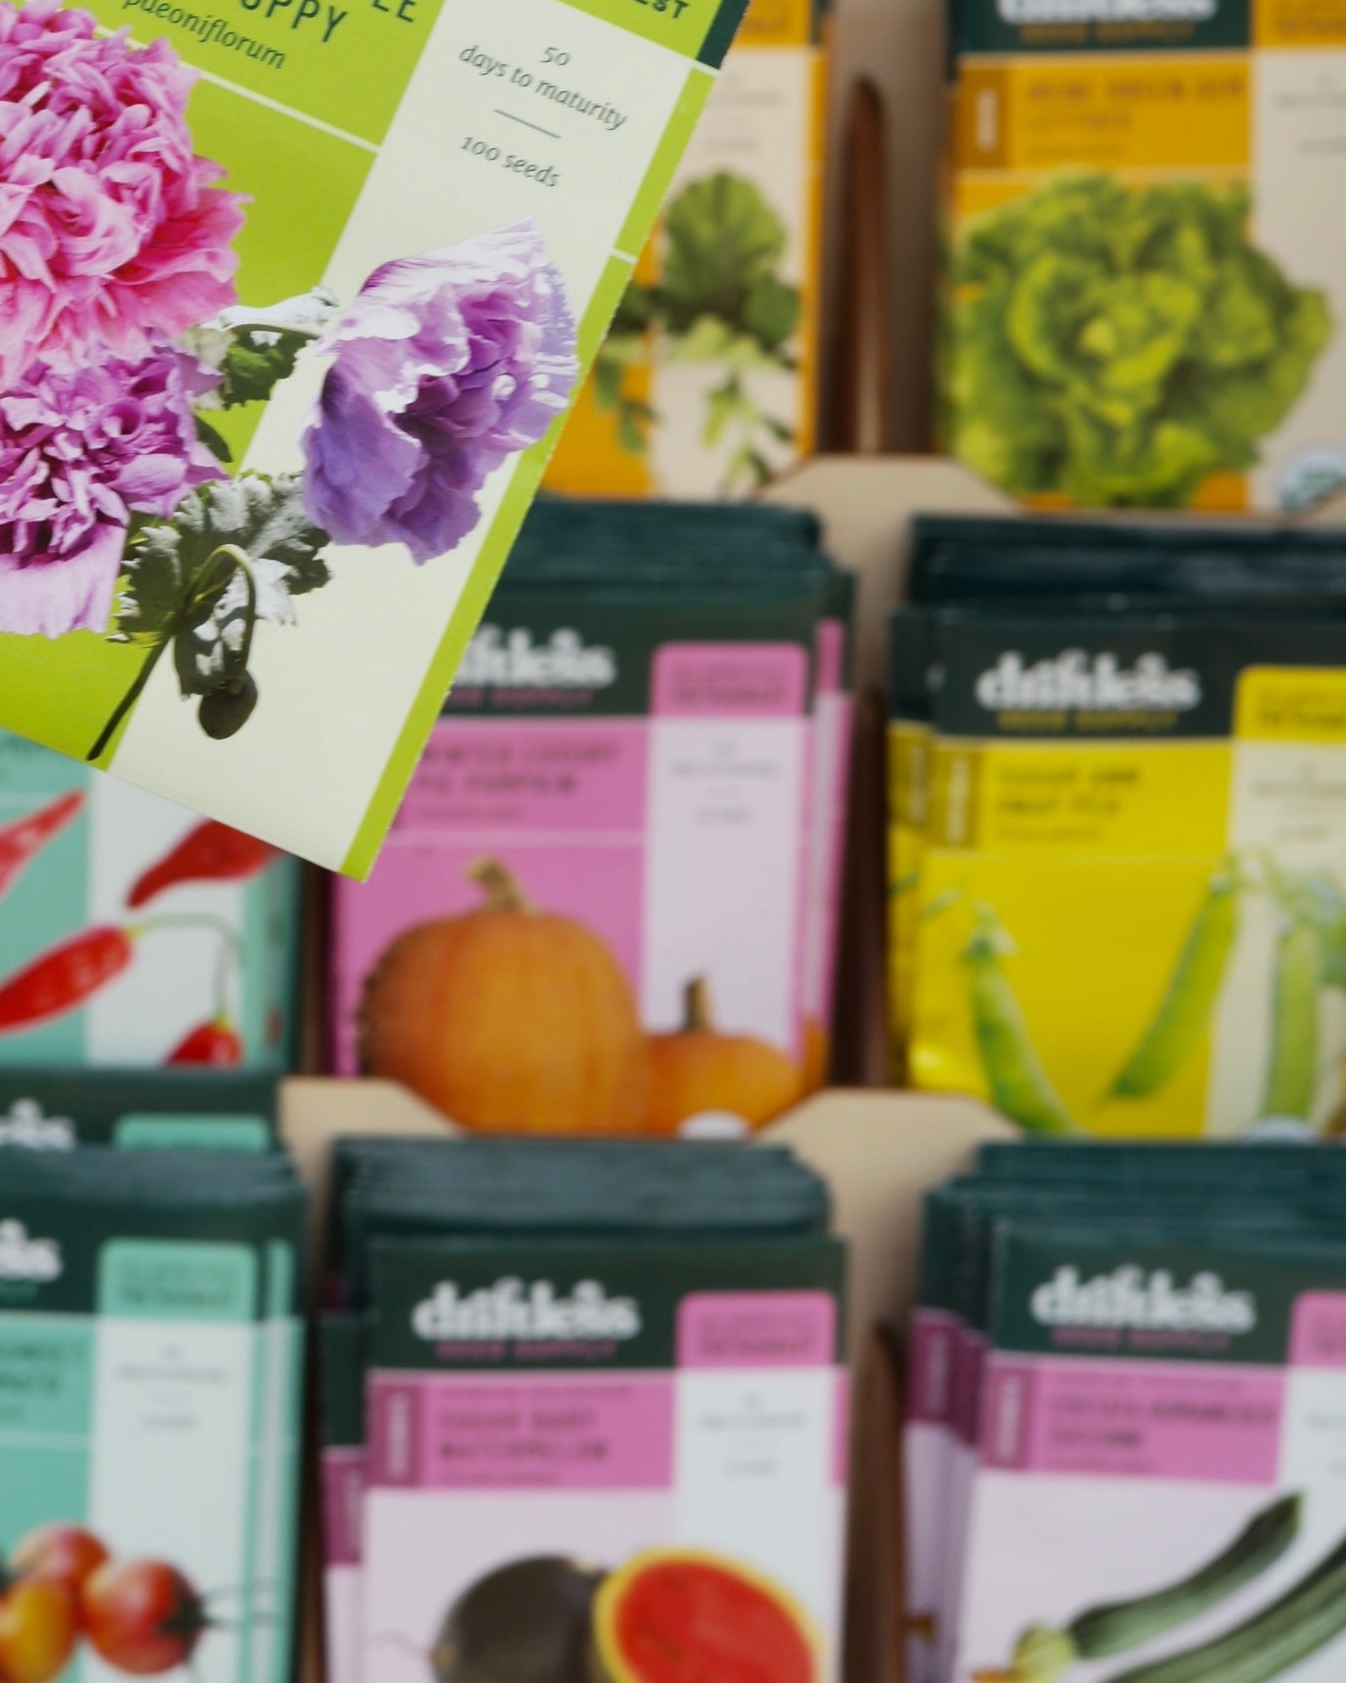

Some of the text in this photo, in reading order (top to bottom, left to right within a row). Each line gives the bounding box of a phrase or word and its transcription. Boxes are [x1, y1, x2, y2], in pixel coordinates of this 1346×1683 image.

[539, 46, 573, 67] 50
[458, 44, 629, 132] days to maturity
[460, 135, 563, 188] 100 seeds
